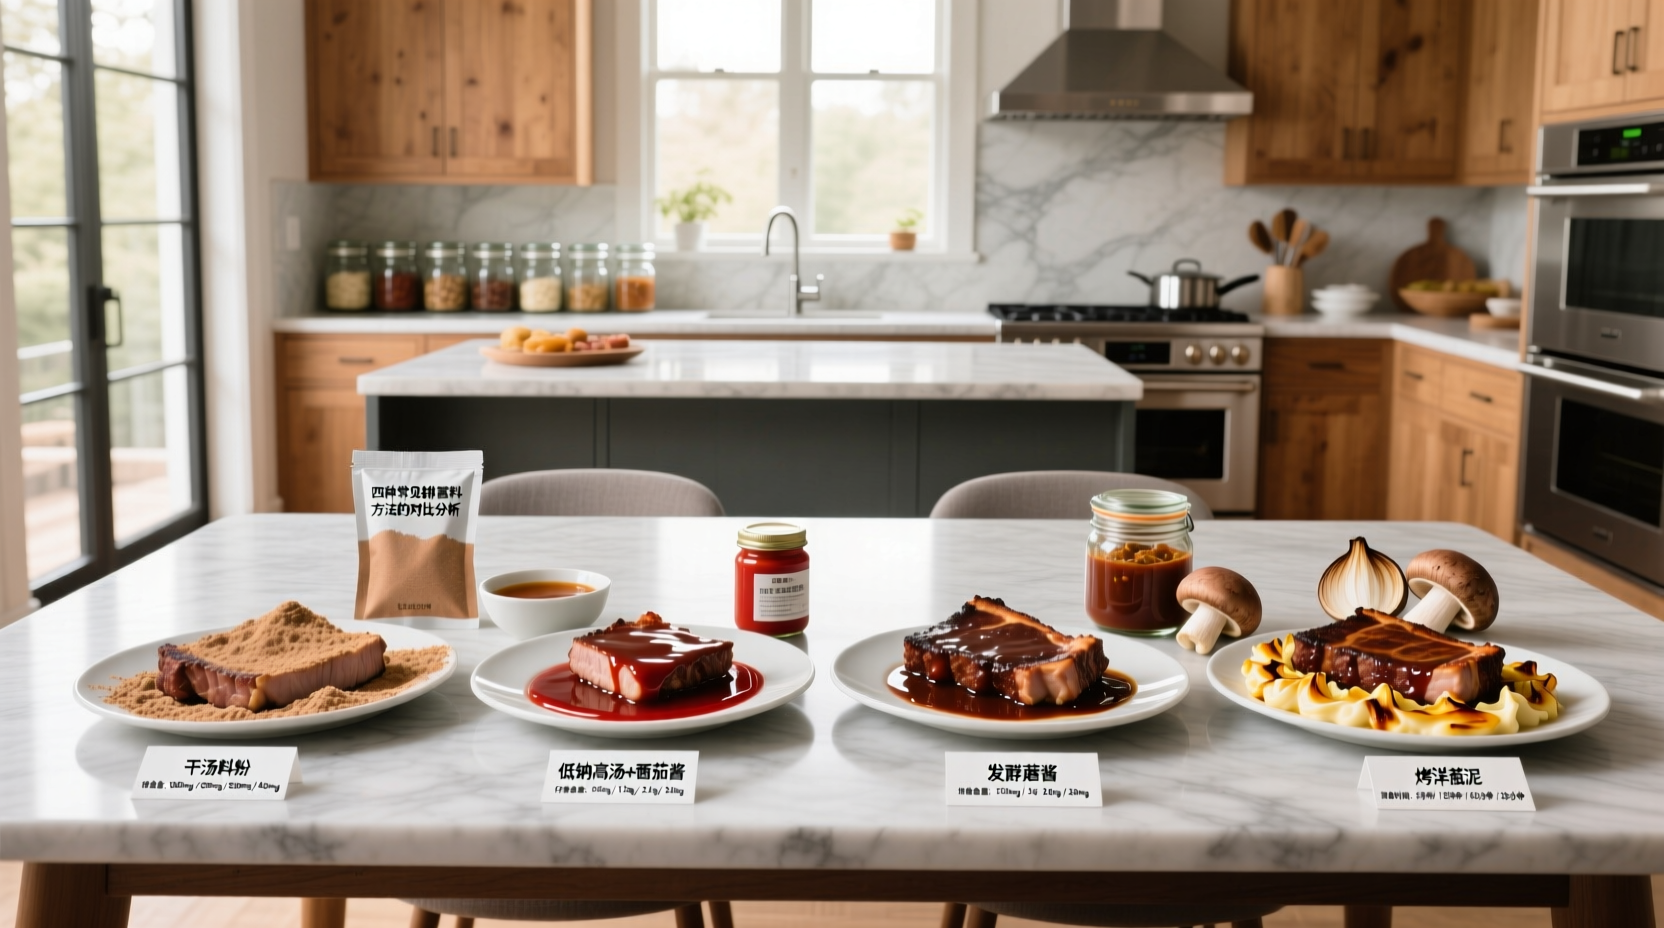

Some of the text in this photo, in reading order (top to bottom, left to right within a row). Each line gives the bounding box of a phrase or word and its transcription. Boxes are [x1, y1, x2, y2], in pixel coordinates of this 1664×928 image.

[371, 501, 461, 517] 方法的对比分析
